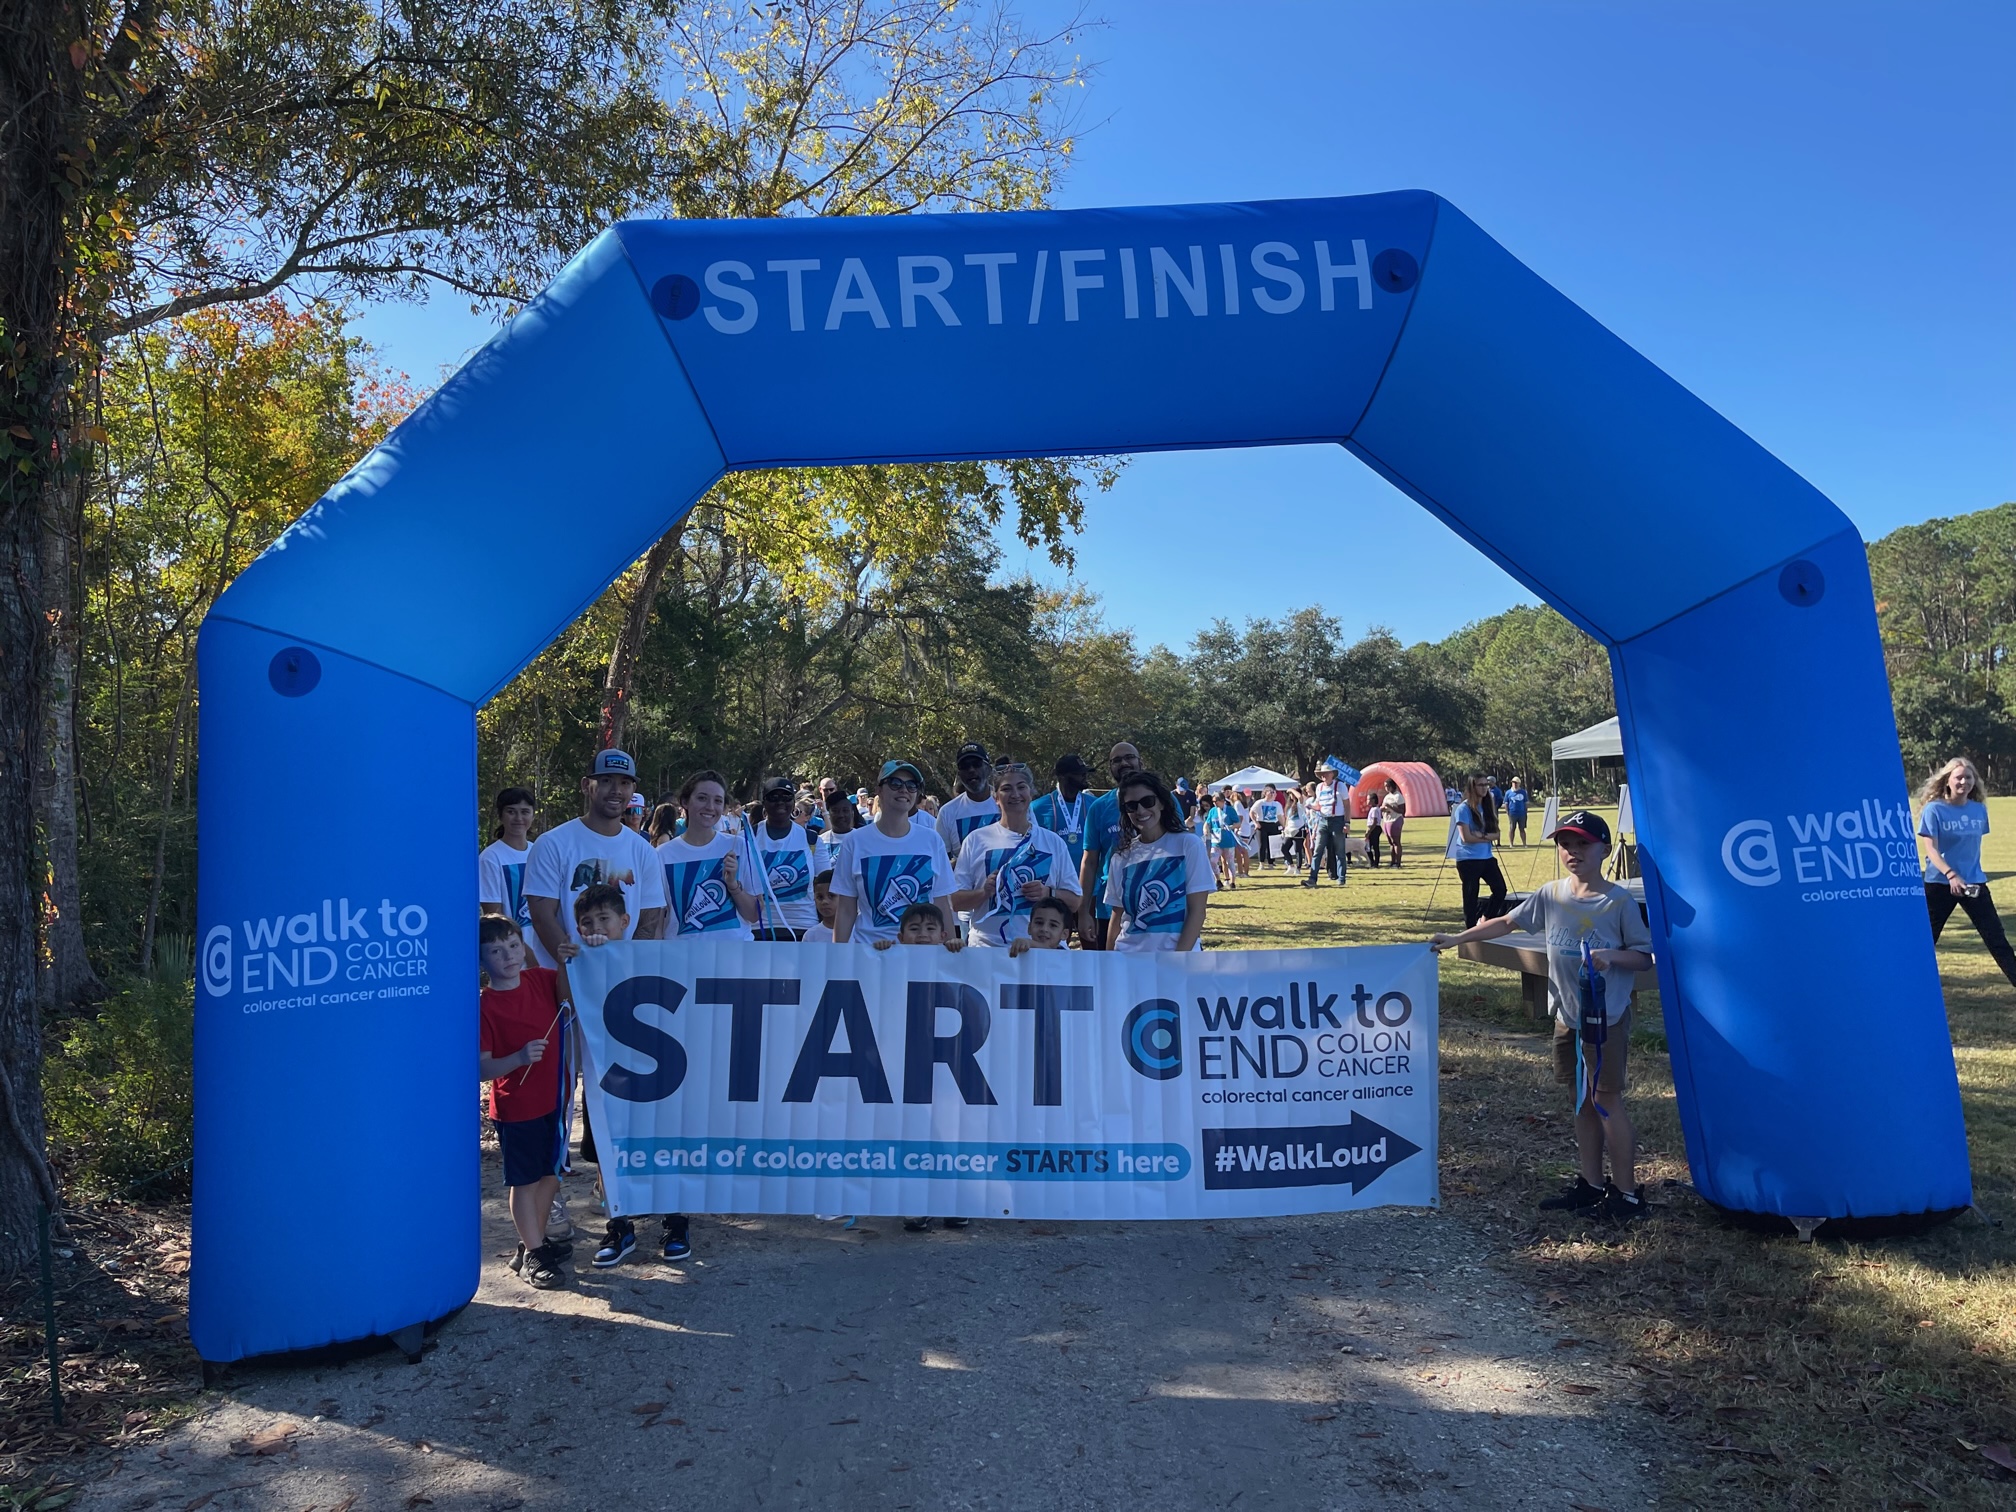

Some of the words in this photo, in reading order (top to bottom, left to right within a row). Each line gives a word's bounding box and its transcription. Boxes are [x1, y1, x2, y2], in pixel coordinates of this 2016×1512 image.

[703, 239, 1373, 334] START/FINISH
[1332, 757, 1354, 775] TEAM
[1787, 799, 1897, 843] walk
[1793, 842, 1884, 883] END
[1886, 842, 1917, 859] COLO
[1889, 861, 1922, 877] CANCE
[1802, 886, 1874, 903] colorectal
[1876, 886, 1909, 898] cancer
[243, 898, 369, 950] walk
[378, 899, 428, 937] to
[346, 938, 428, 961] COLON
[243, 947, 338, 993] END
[346, 960, 428, 981] CANCER
[243, 994, 316, 1014] colorectal
[320, 989, 375, 1005] cancer
[378, 984, 430, 999] alliance
[1197, 982, 1342, 1031] walk
[1351, 983, 1412, 1028] to
[599, 975, 1094, 1107] START
[1316, 1031, 1411, 1055] COLON
[1199, 1034, 1309, 1080] END
[1317, 1056, 1411, 1078] CANCER
[1202, 1088, 1287, 1104] colorectal
[1291, 1087, 1350, 1103] cancer
[1352, 1085, 1413, 1100] alliance
[614, 1145, 646, 1168] he
[654, 1144, 708, 1167] end
[715, 1145, 747, 1168] of
[753, 1146, 896, 1170] colorectal
[903, 1152, 998, 1172] cancer
[1006, 1149, 1109, 1173] STARTS
[1117, 1150, 1180, 1174] here
[1215, 1138, 1387, 1172] #WalkLoud
